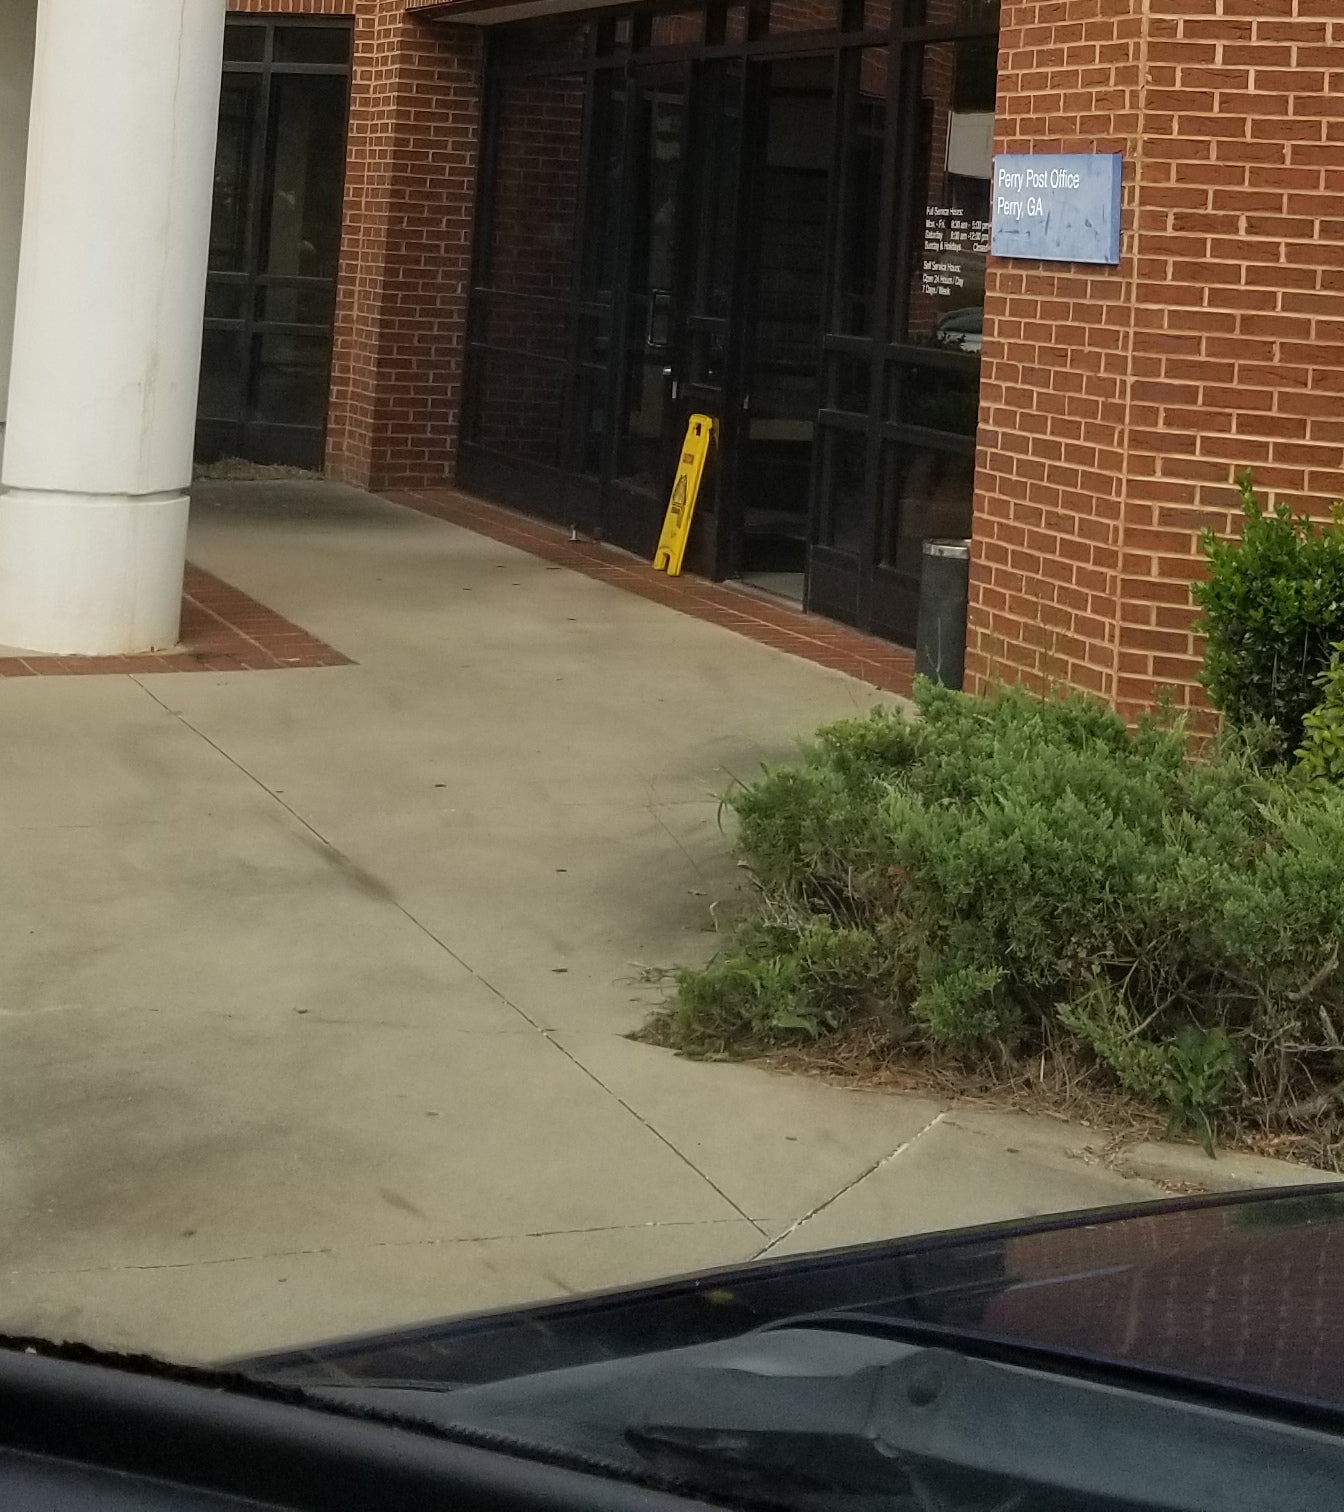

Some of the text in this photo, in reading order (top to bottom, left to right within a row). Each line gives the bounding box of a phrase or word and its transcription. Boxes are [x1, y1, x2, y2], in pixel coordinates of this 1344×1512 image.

[998, 168, 1080, 193] Perry Post Office
[997, 196, 1043, 221] Perry, GA
[931, 261, 947, 271] Service
